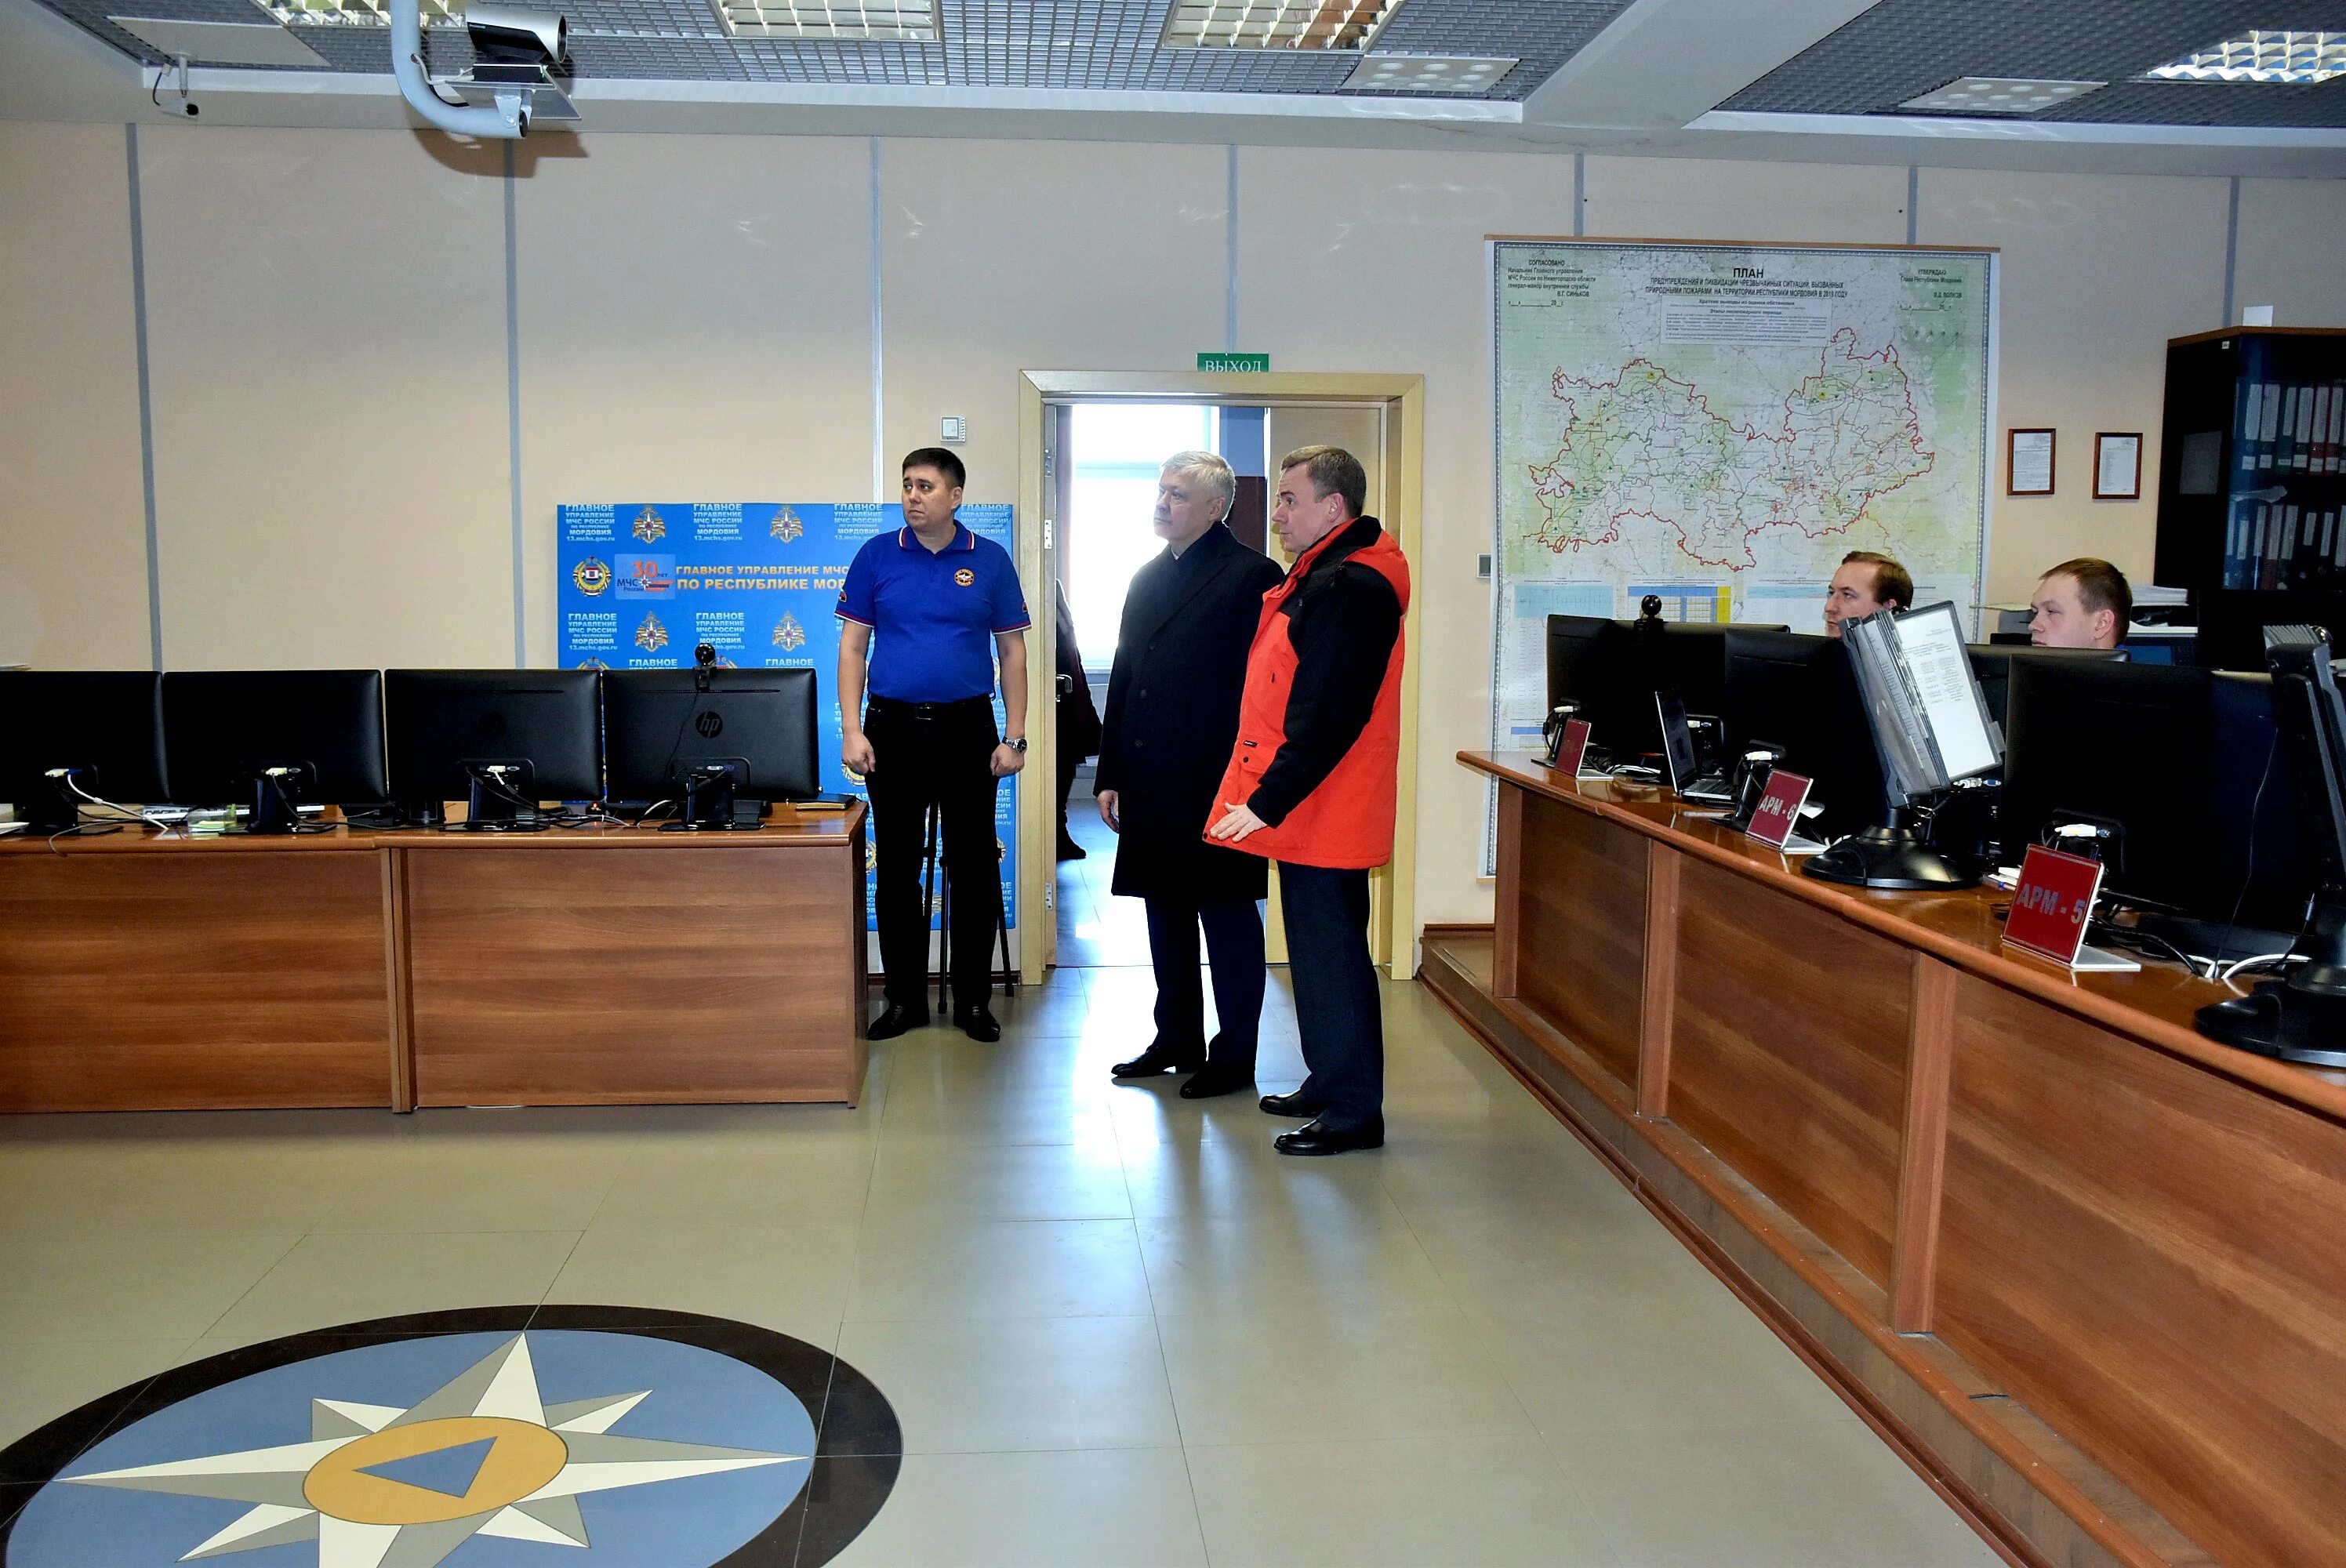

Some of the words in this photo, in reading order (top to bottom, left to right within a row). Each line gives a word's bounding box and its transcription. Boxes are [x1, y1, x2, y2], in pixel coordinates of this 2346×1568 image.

[1734, 267, 1764, 278] ПЛАН
[1205, 360, 1262, 372] ВЫХОД
[632, 561, 658, 578] 30
[676, 566, 733, 575] ГЛАВНОЕ
[737, 566, 819, 575] УПРАВЛЕНИЕ
[823, 565, 849, 575] МЧС
[677, 579, 700, 590] ПО
[703, 579, 808, 590] РЕСПУБЛИКЕ
[699, 711, 720, 737] hp
[2016, 883, 2058, 916] АРМ
[2070, 899, 2086, 924] 5
